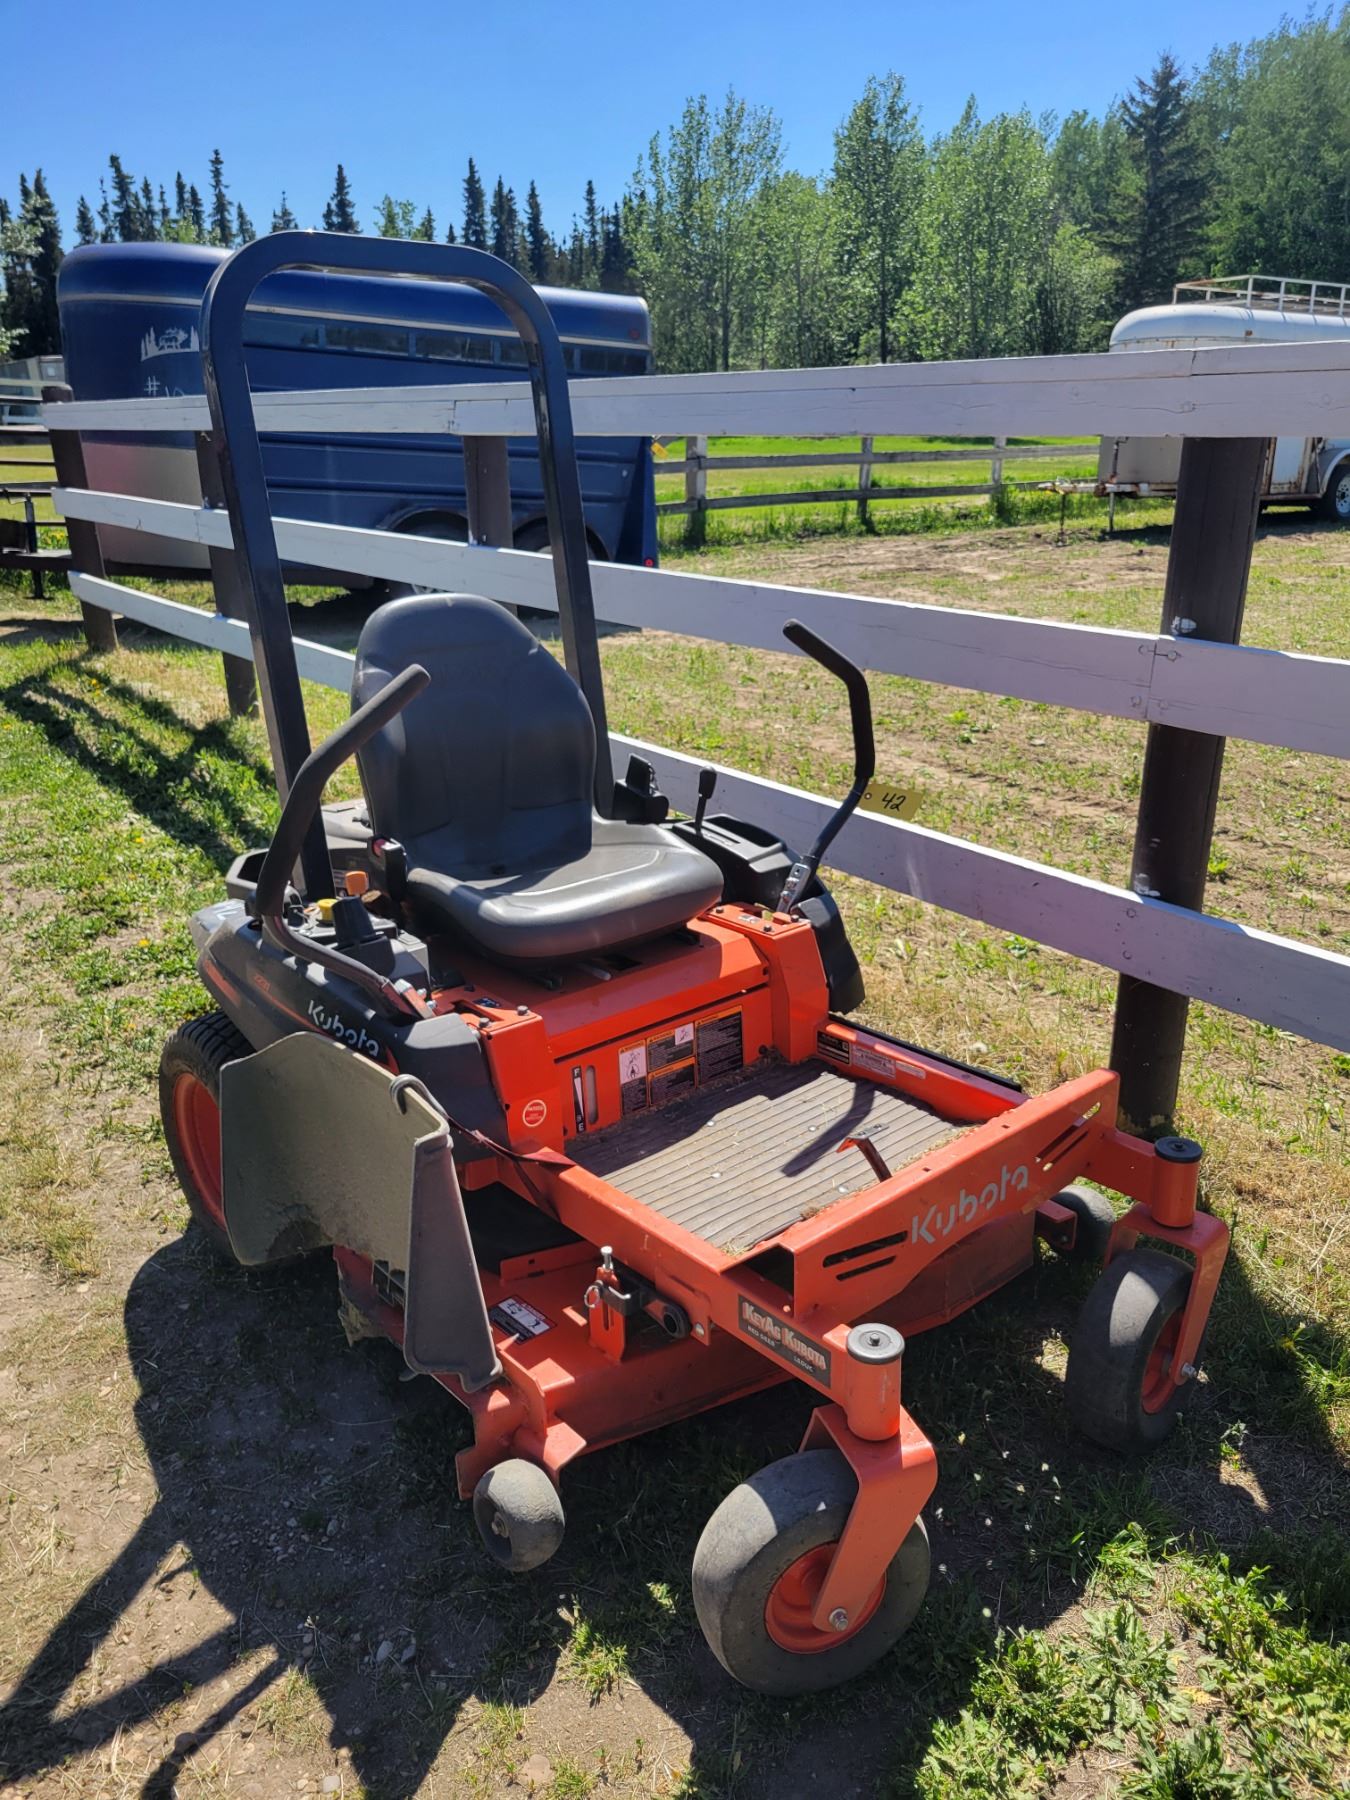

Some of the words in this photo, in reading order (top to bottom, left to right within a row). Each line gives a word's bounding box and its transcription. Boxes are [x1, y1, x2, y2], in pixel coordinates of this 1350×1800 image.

[882, 793, 906, 812] 42
[307, 1000, 380, 1057] Kubota
[911, 1165, 1029, 1245] Kubota
